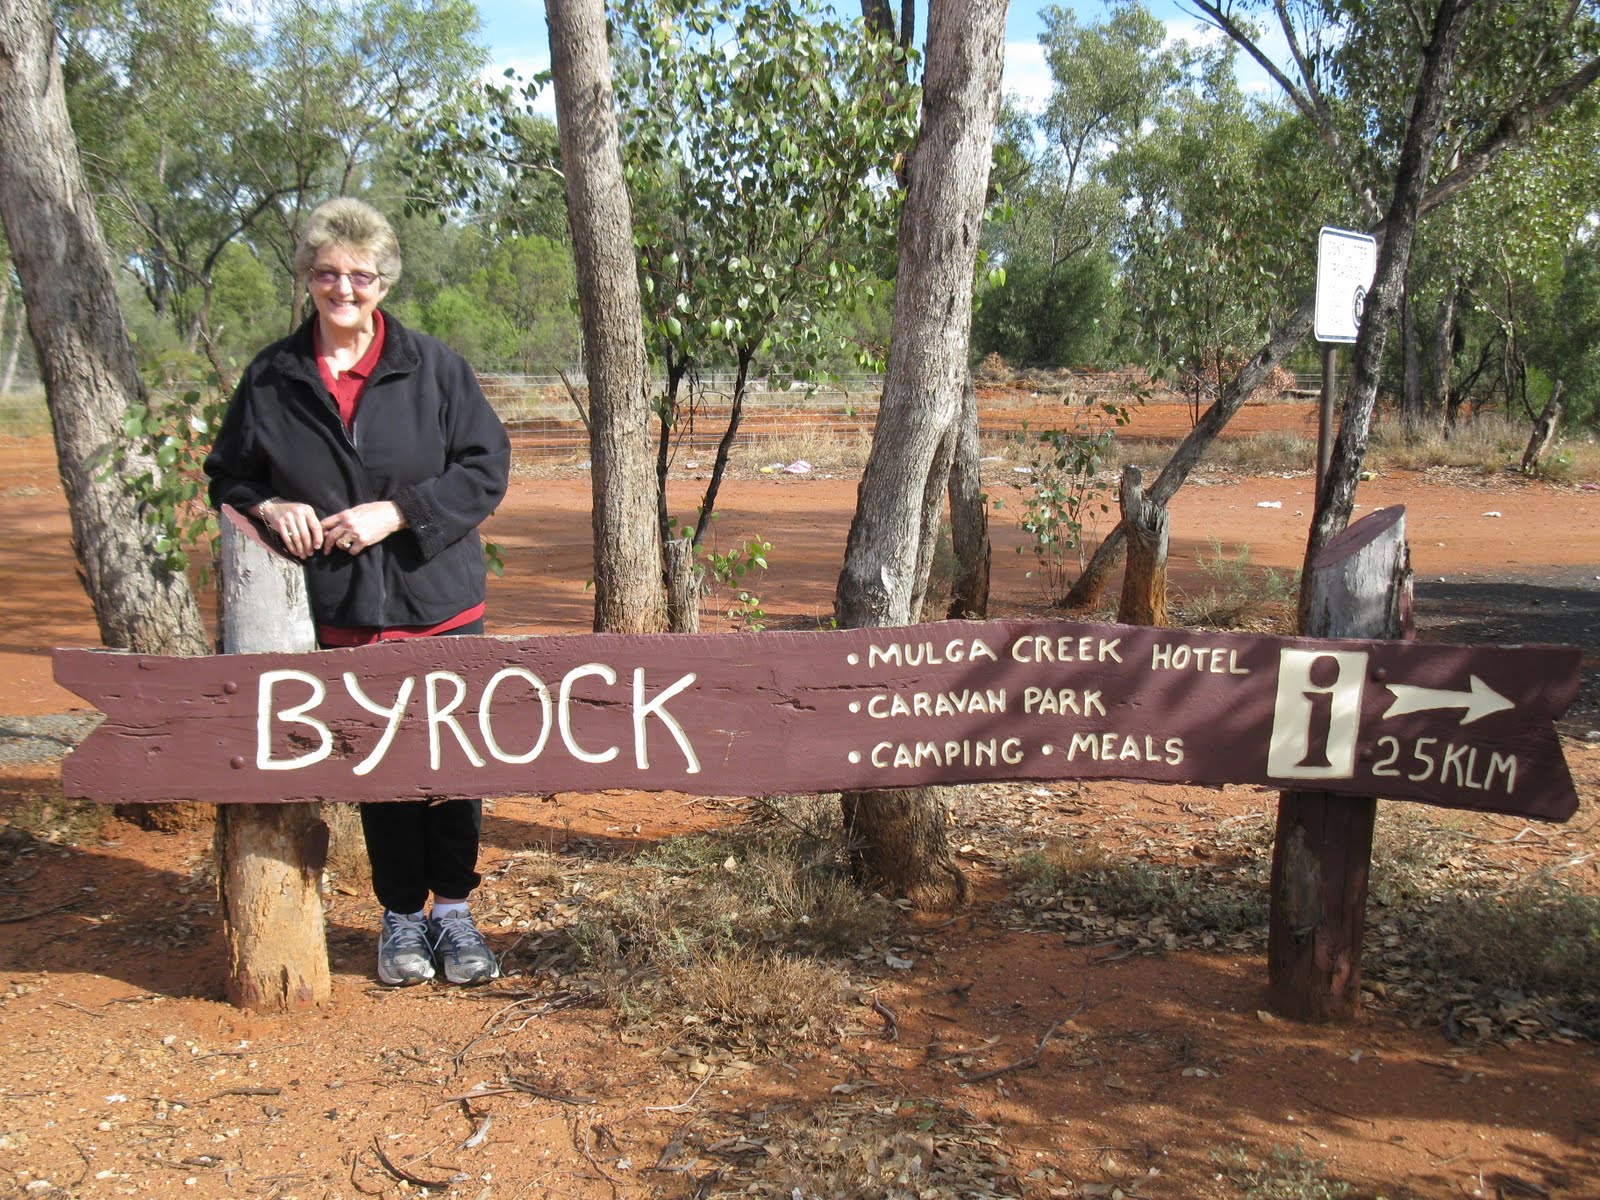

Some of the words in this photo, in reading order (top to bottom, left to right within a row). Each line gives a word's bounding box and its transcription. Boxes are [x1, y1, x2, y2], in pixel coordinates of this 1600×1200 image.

[868, 639, 998, 669] MULGA
[1012, 635, 1123, 664] CREEK
[1151, 643, 1250, 675] HOTEL
[257, 663, 700, 776] BYROCK
[867, 688, 1007, 719] CARAVAN
[1024, 687, 1107, 717] PARK
[870, 738, 1024, 768] CAMPING
[1067, 732, 1184, 766] MEALS
